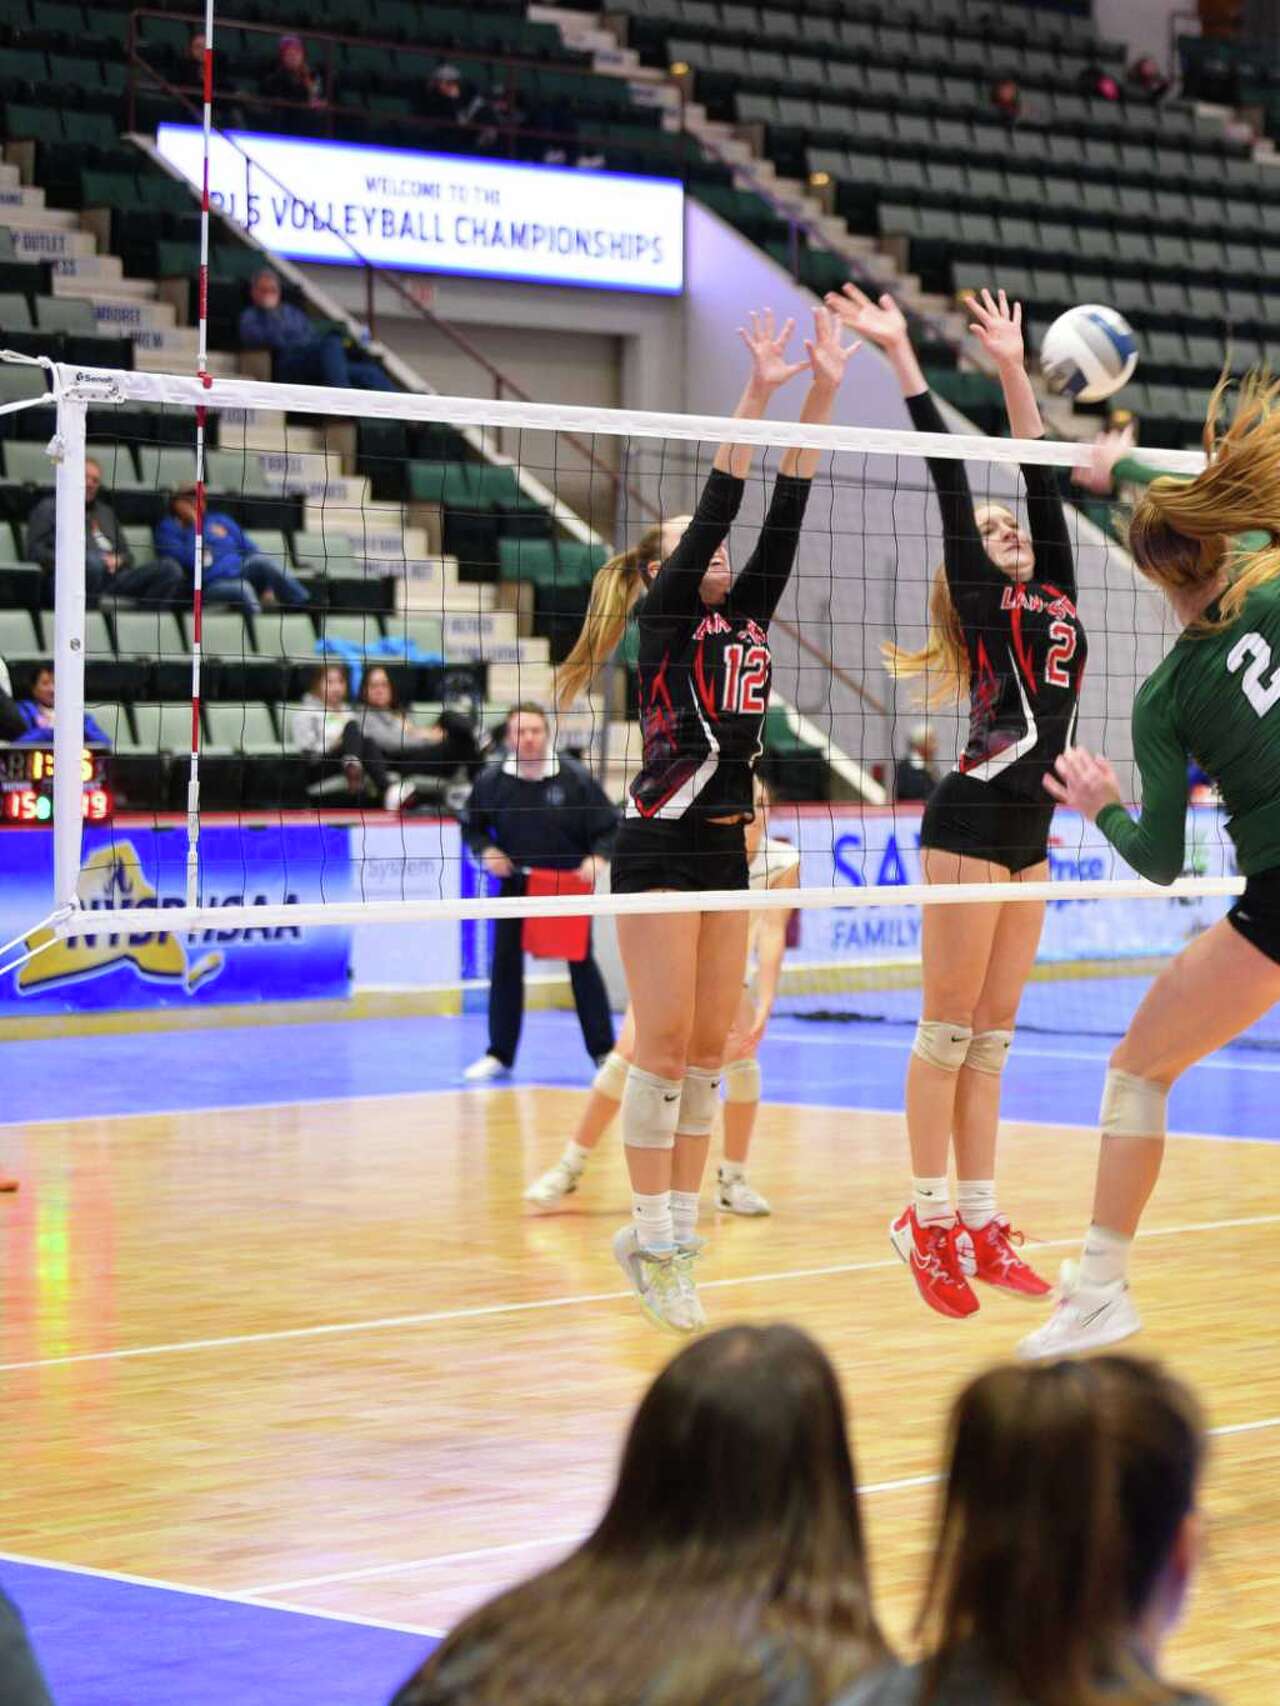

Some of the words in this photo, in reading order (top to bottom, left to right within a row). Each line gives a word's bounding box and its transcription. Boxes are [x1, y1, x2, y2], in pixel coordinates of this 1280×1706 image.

[364, 176, 441, 200] WELCOME
[271, 197, 446, 244] VOLLEYBALL
[455, 215, 664, 264] CHAMPIONSHIPS
[721, 643, 771, 714] 12
[1044, 620, 1077, 688] 2
[832, 918, 921, 949] FAMILY
